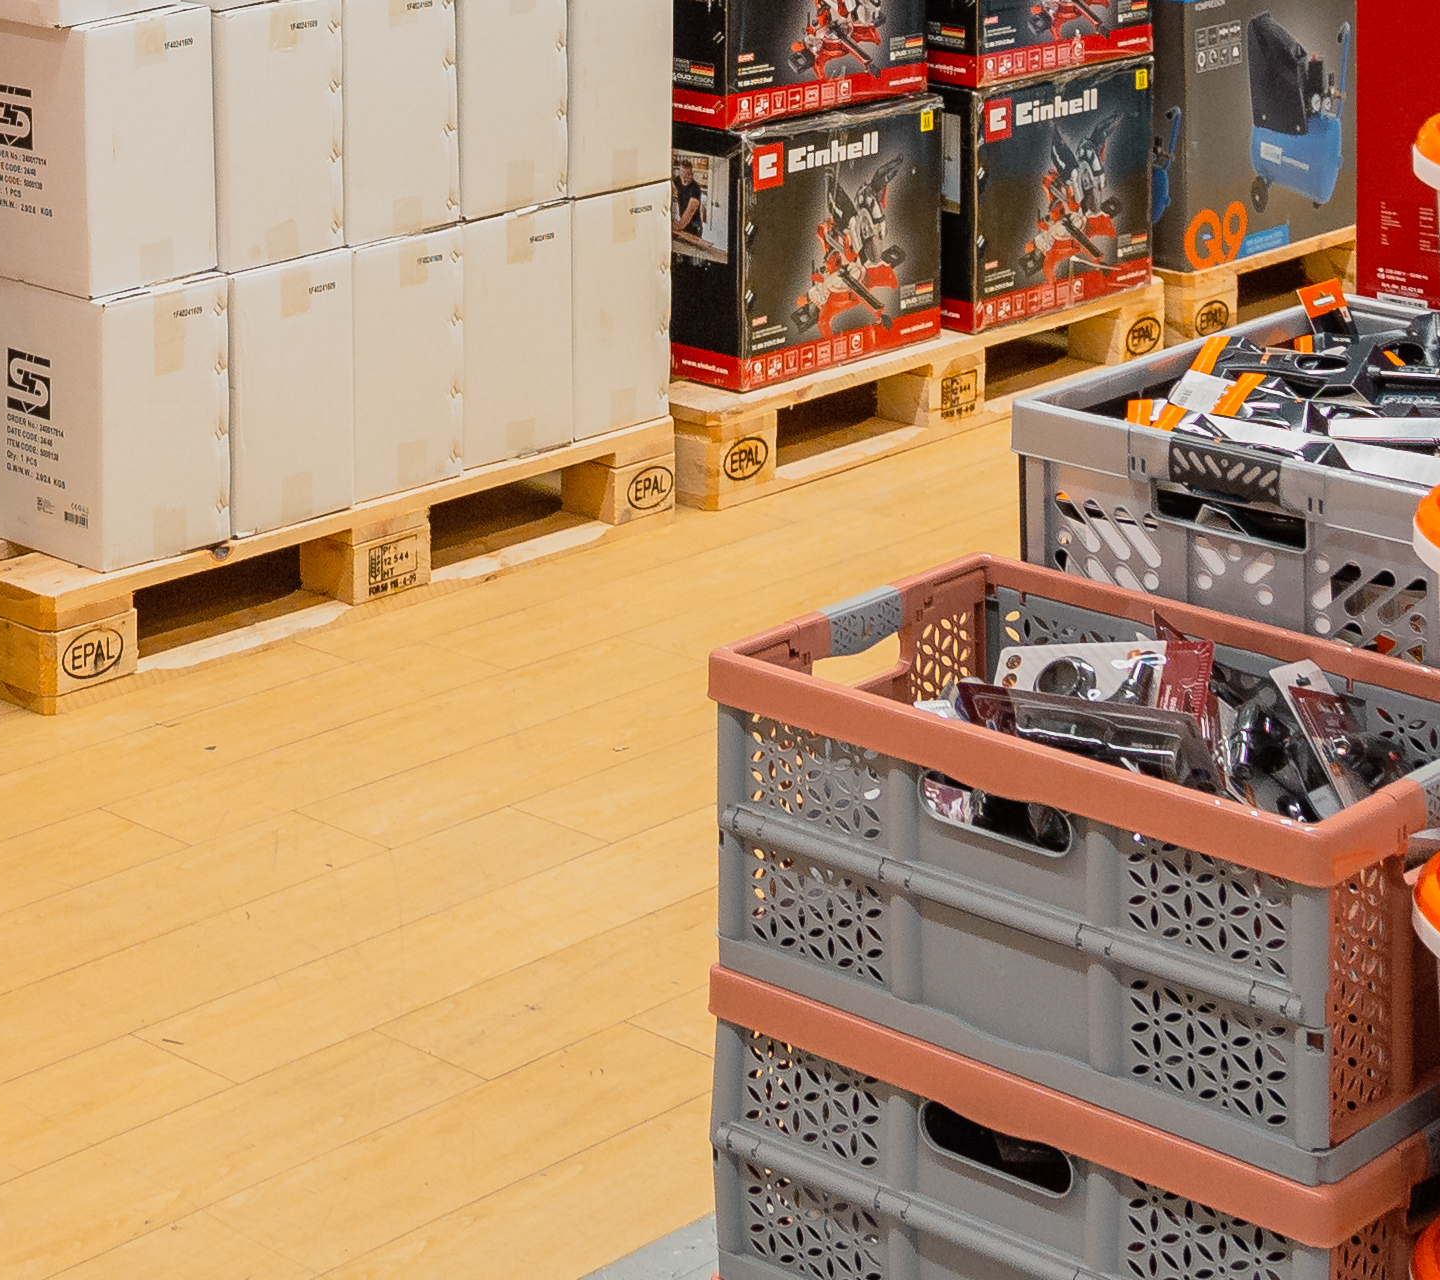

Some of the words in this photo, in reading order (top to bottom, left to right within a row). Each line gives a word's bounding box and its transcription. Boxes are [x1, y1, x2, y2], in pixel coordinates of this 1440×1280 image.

[788, 132, 878, 173] Einhell
[634, 475, 667, 506] EPAL
[70, 633, 117, 672] EPAL
